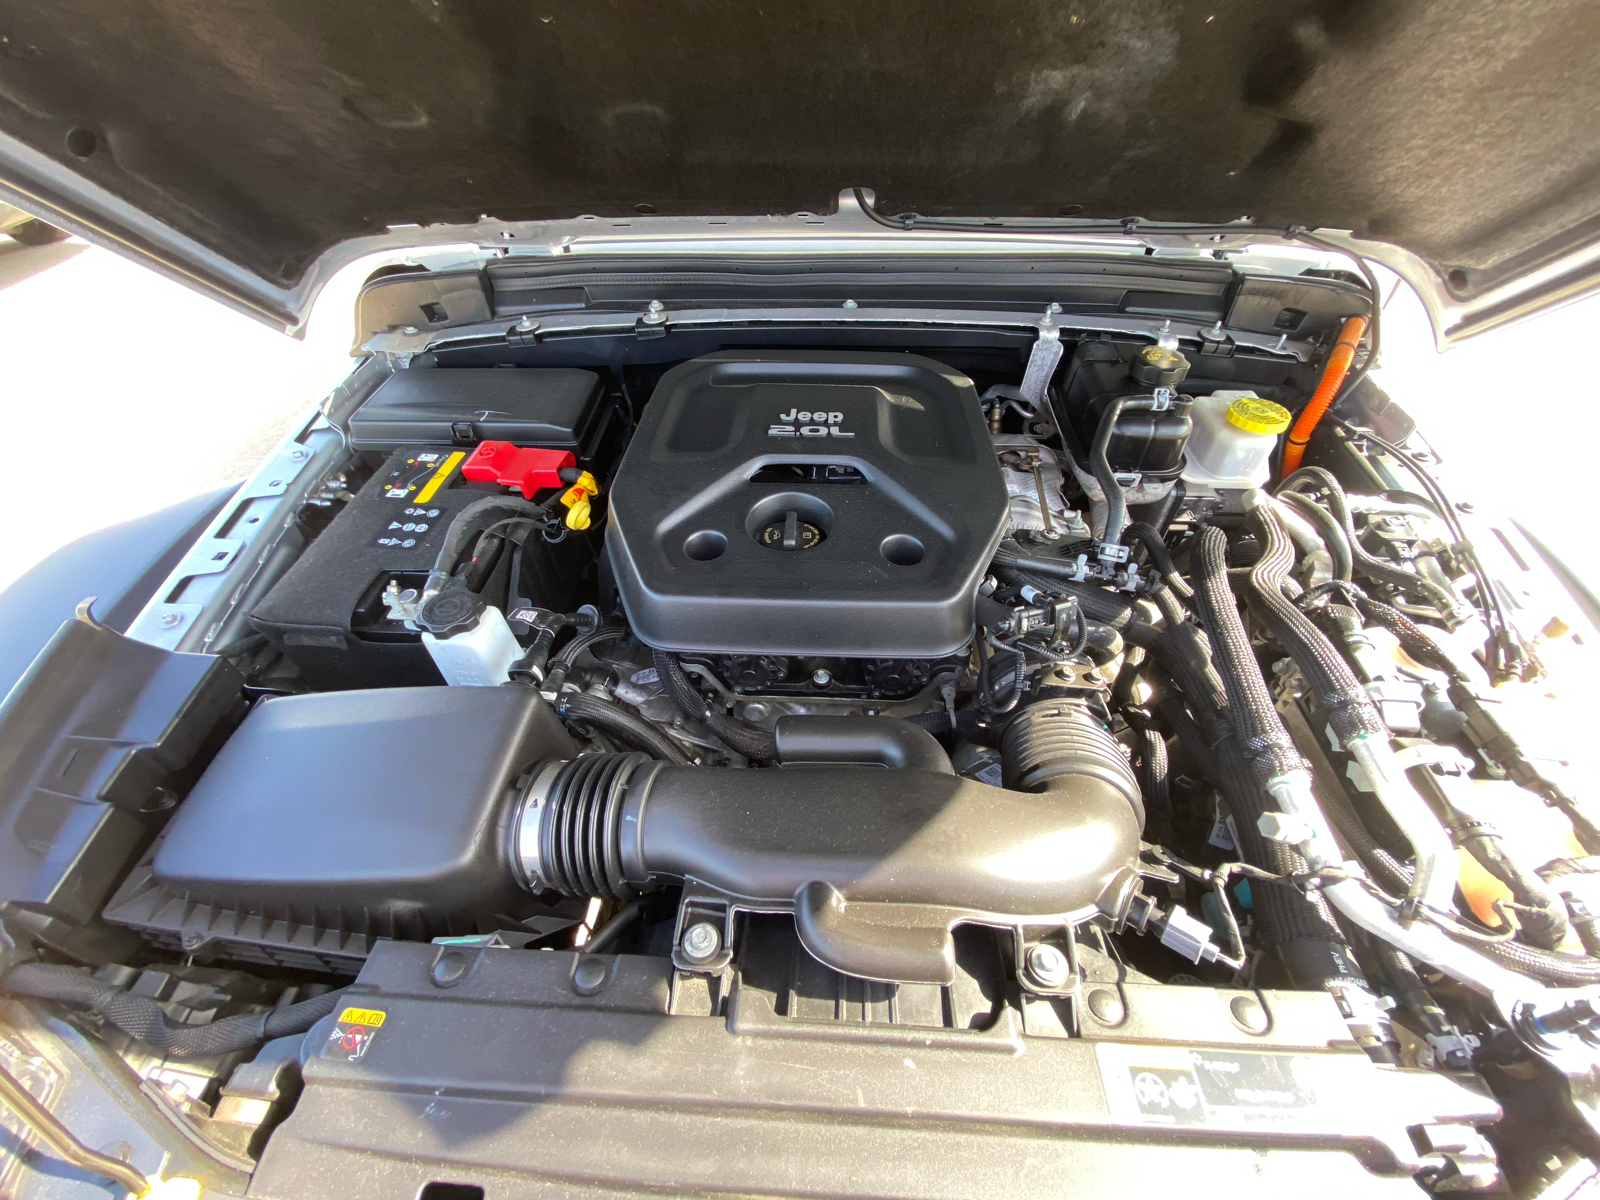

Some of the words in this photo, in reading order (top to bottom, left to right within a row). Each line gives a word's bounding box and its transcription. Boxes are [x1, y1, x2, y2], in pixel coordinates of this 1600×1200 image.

[780, 409, 844, 424] Jeep
[768, 425, 855, 437] 2.0L
[1329, 951, 1349, 973] PHEV
